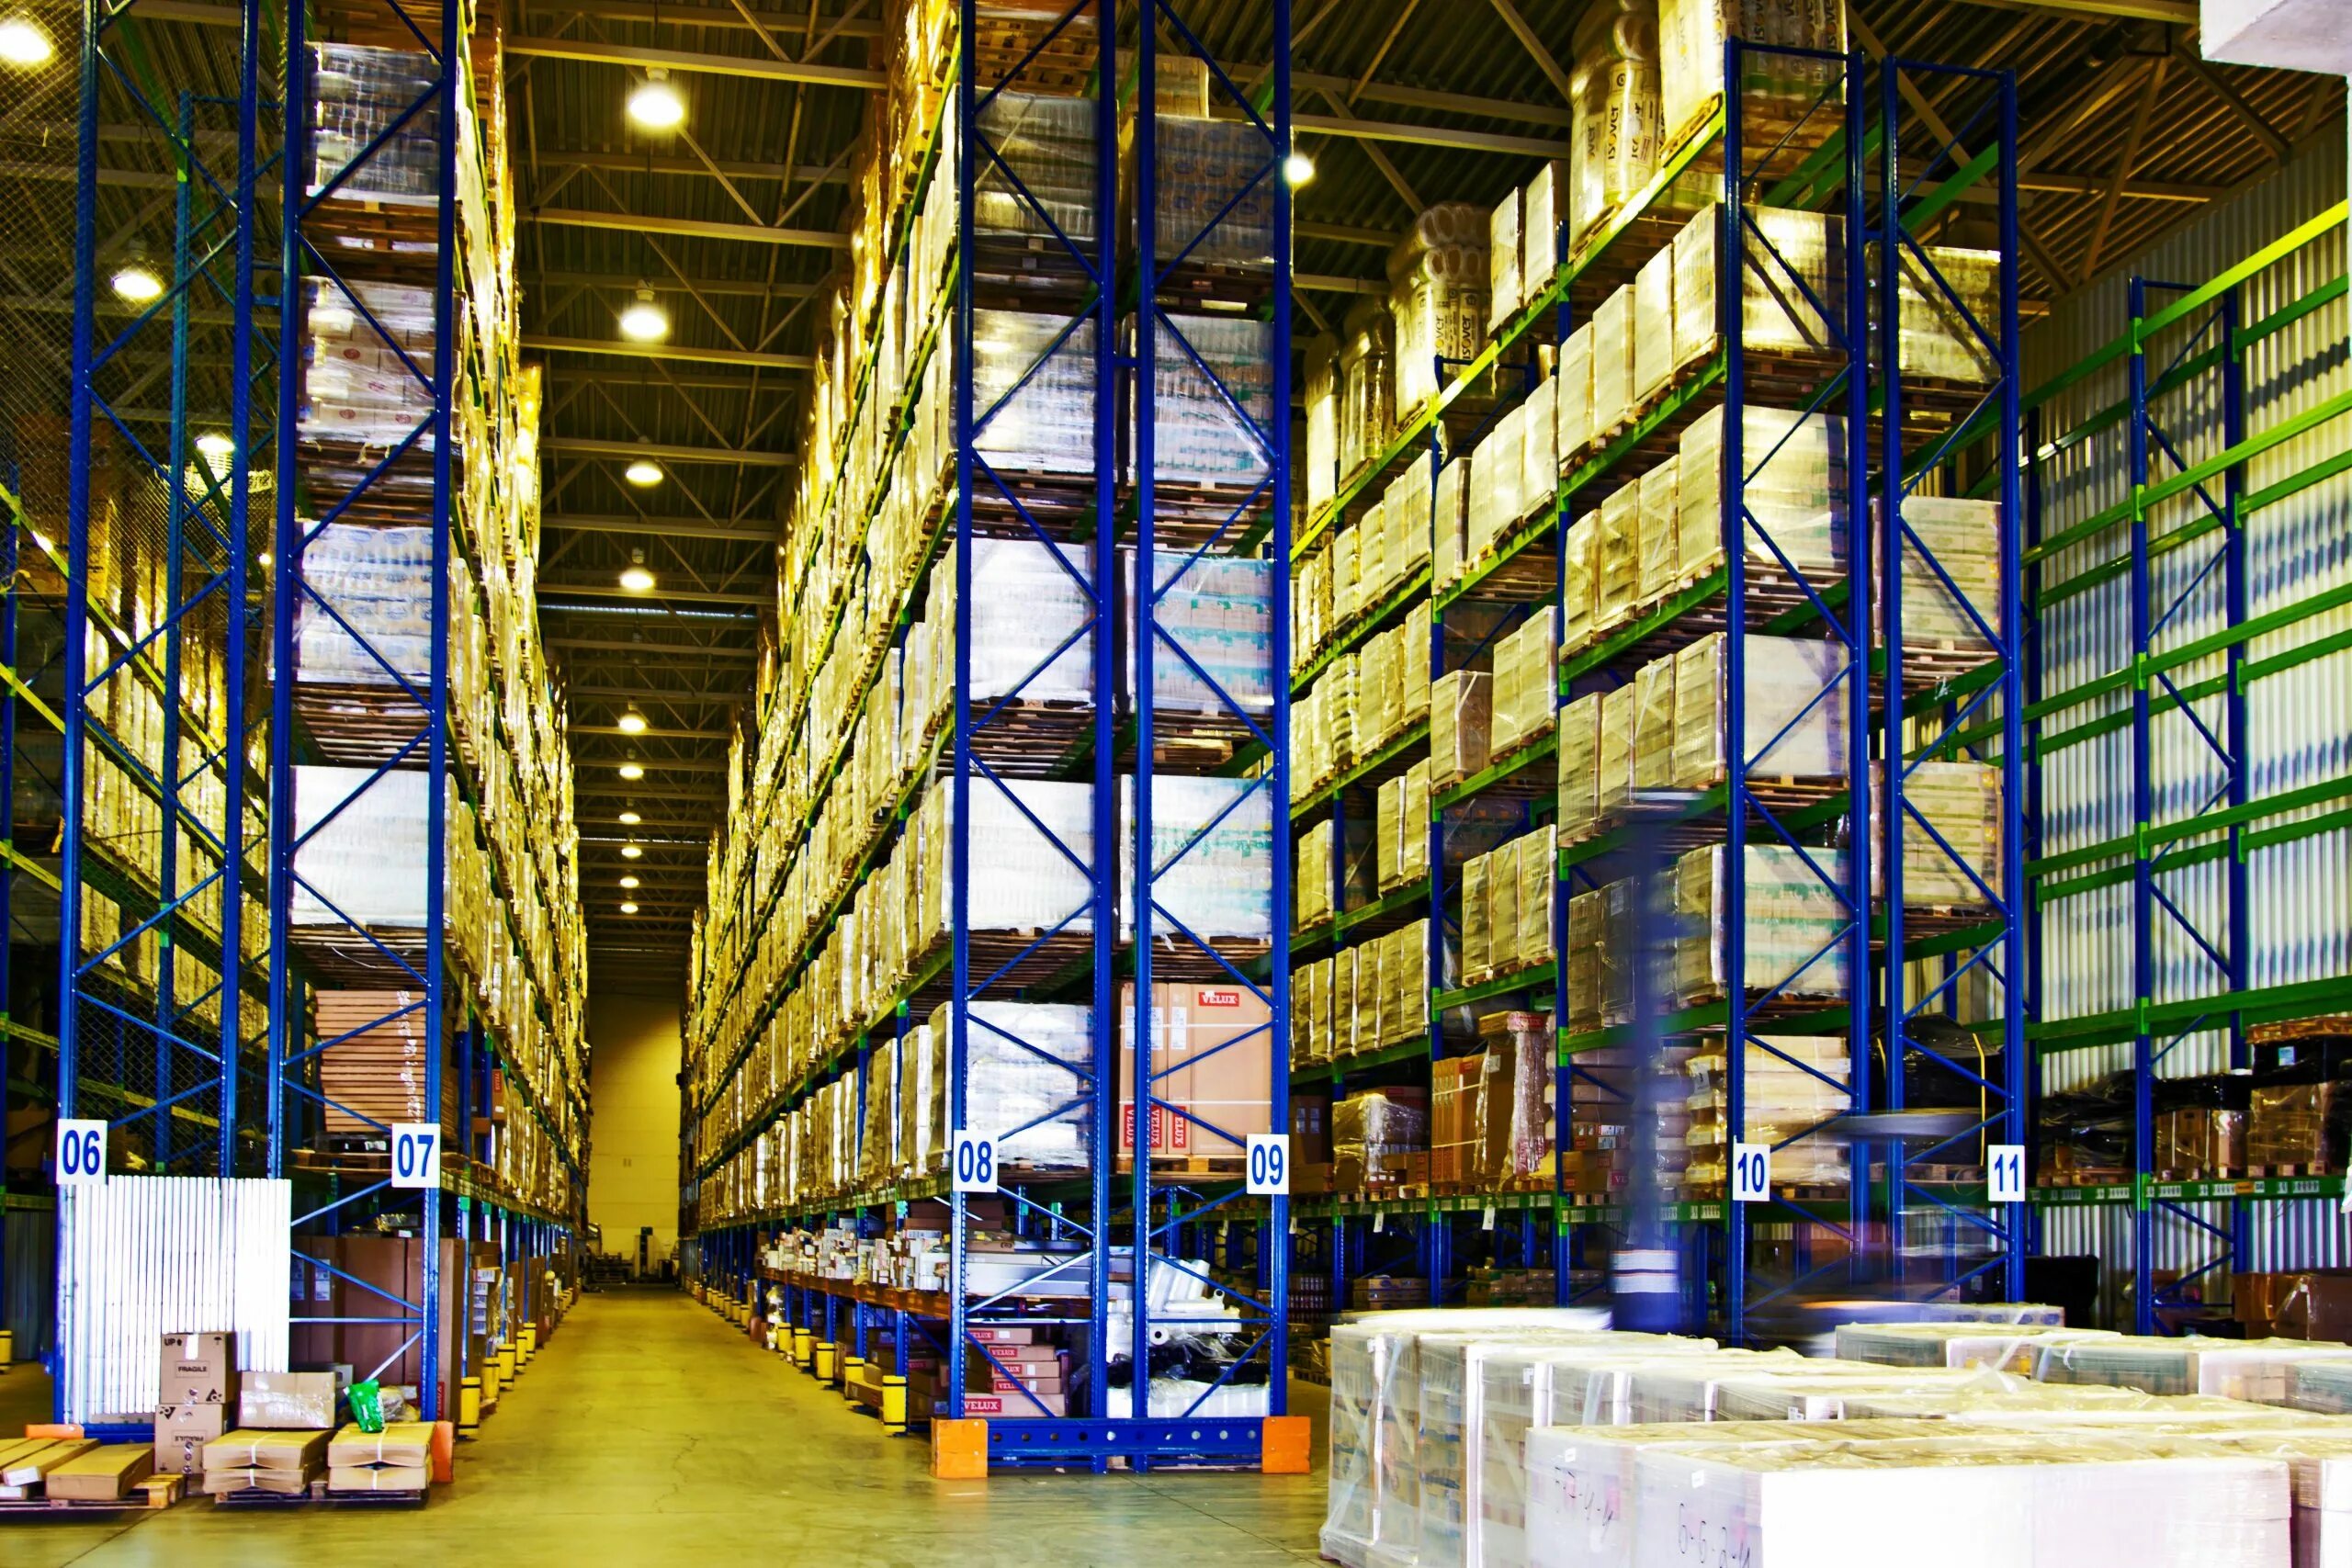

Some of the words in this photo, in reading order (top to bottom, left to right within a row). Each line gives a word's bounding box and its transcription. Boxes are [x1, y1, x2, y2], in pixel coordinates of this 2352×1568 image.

[1202, 995, 1237, 1004] VELUX
[1151, 1109, 1159, 1145] VELUX
[1175, 1116, 1184, 1145] ELUX
[62, 1130, 100, 1175] 06
[398, 1134, 434, 1178] 07
[958, 1140, 992, 1183] 08
[1252, 1144, 1283, 1185] 09
[1738, 1153, 1765, 1192] 10
[1995, 1154, 2018, 1191] 11
[164, 1337, 175, 1346] UP
